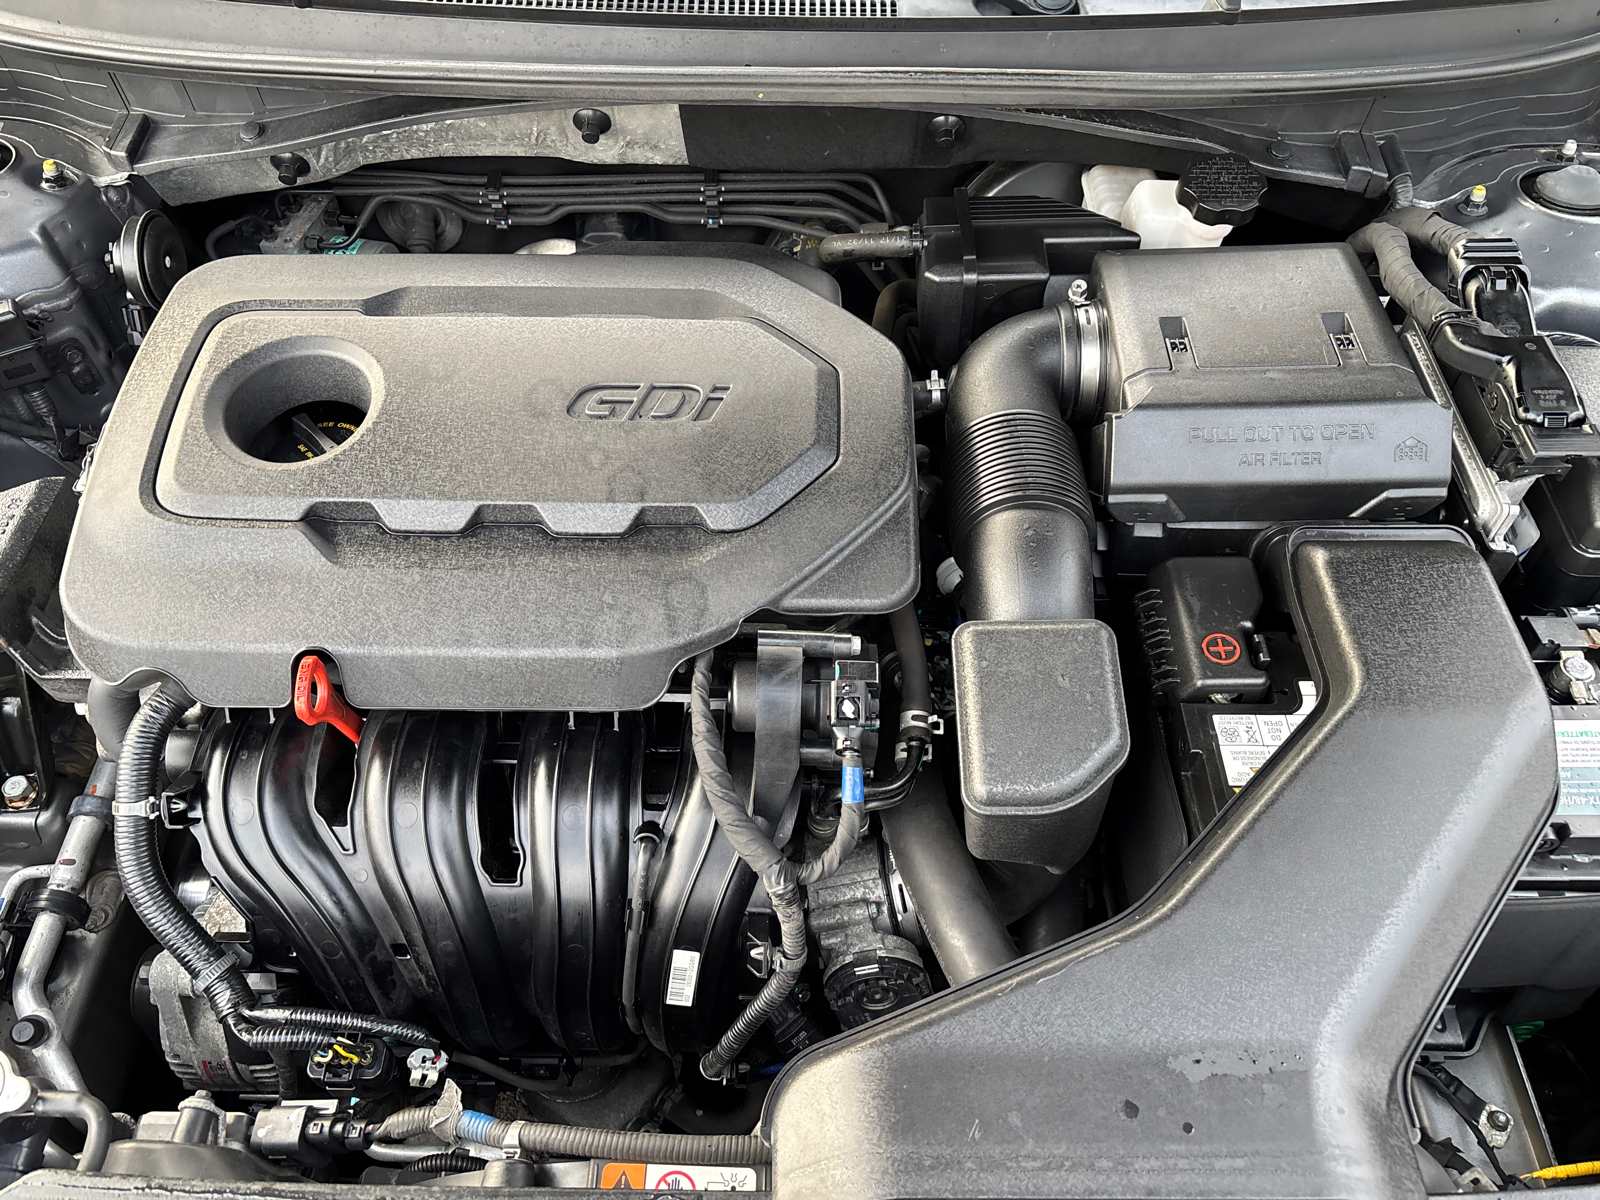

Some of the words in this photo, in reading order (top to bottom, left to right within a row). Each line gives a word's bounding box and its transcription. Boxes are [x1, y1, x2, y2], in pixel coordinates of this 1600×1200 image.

[847, 237, 874, 245] 11/32
[566, 382, 733, 422] GDi
[1188, 427, 1239, 444] PULL
[1243, 425, 1284, 442] OUT
[1289, 424, 1315, 441] TO
[1321, 423, 1375, 441] OPEN
[1238, 452, 1265, 467] AIR
[1269, 451, 1322, 466] FILTER
[298, 663, 310, 683] ENG
[296, 685, 307, 703] OIL
